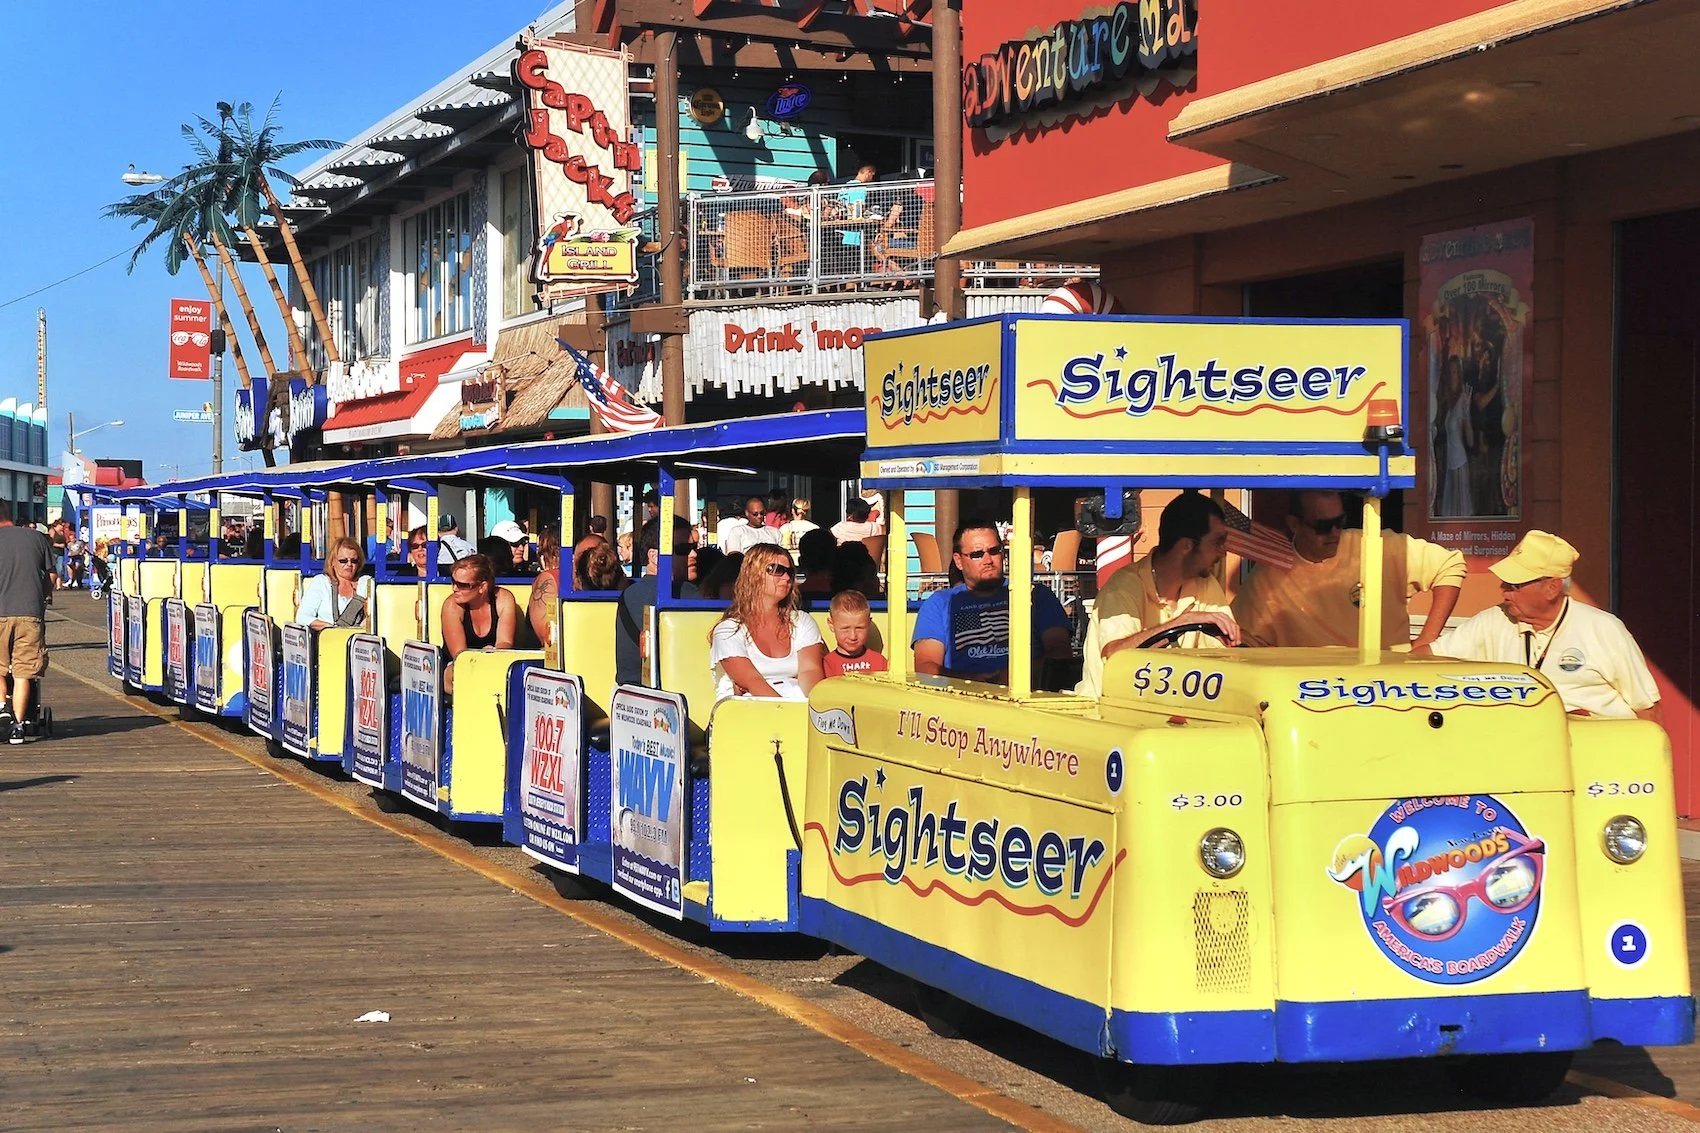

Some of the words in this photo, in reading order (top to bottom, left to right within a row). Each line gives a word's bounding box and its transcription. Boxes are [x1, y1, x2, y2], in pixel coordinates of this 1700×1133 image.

[1139, 0, 1198, 57] Ma
[774, 93, 807, 115] Lite
[1463, 280, 1477, 293] 100
[1478, 279, 1505, 294] Mirrors
[174, 314, 207, 323] summer
[179, 305, 203, 315] enjoy
[723, 323, 804, 355] Drink
[1055, 343, 1367, 418] Sightseer
[879, 360, 991, 426] Sightseer
[174, 412, 200, 420] JUNIPER
[200, 412, 213, 420] AVE
[880, 465, 891, 474] Owned
[940, 463, 958, 473] Management
[959, 462, 978, 472] Corporation
[1436, 531, 1454, 541] Maze
[1455, 530, 1462, 541] of
[1463, 531, 1490, 543] Mirrors,
[1491, 530, 1517, 541] Hidden
[1474, 544, 1508, 557] Surprises!
[967, 646, 987, 658] Old
[988, 644, 1009, 657] Nav
[841, 661, 871, 672] SHARK
[1133, 661, 1224, 701] $3.00
[1299, 677, 1538, 706] Sightseer
[535, 712, 565, 755] 100.7
[896, 709, 922, 740] I'll
[925, 715, 969, 760] Stop
[973, 726, 1080, 776] Anywhere
[646, 739, 660, 756] BEST
[660, 742, 676, 760] Music!
[530, 754, 565, 796] WZXL
[1110, 762, 1118, 778] 1
[619, 747, 676, 824] WAYV
[1586, 781, 1656, 798] $3.00
[1172, 793, 1243, 809] $3.00
[1389, 794, 1472, 824] WELCOME
[1475, 800, 1498, 822] TO
[533, 820, 546, 835] ONLINE
[833, 767, 1106, 899] Sightseer
[1372, 920, 1444, 975] AMERICA'S
[1446, 915, 1527, 976] BOARDWALK
[1621, 935, 1637, 953] 1
